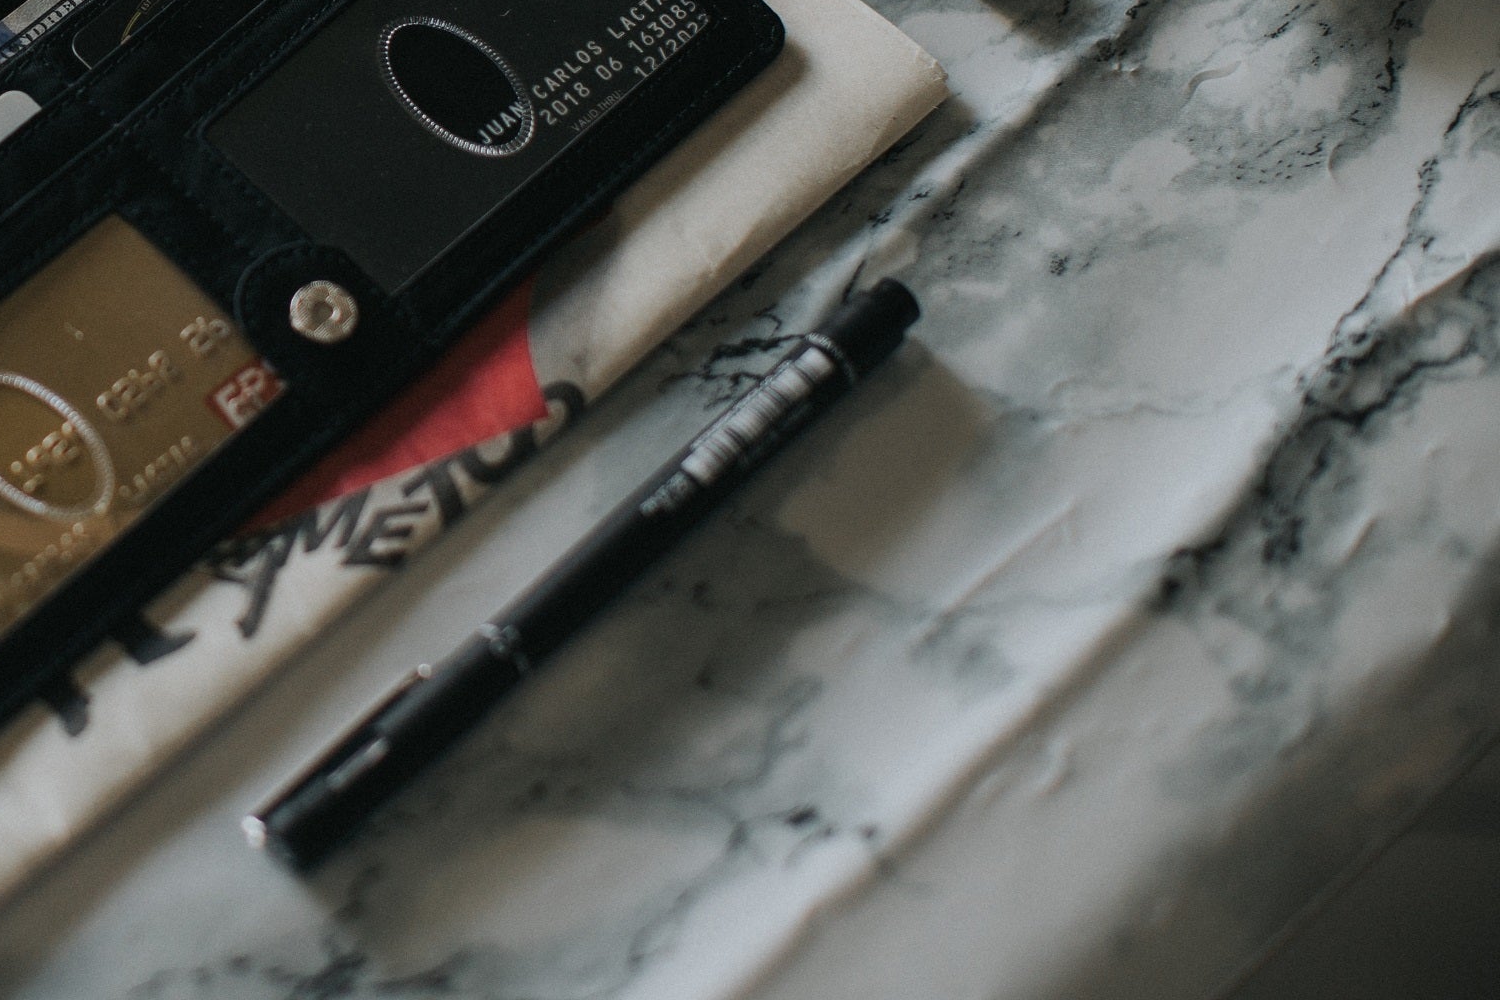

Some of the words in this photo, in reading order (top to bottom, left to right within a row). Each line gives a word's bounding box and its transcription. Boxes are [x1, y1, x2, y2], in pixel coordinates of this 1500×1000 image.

[478, 101, 527, 145] JUAN
[532, 39, 602, 100] CARLOS
[539, 80, 591, 126] 2018
[594, 55, 623, 81] 06
[572, 109, 598, 132] VALID
